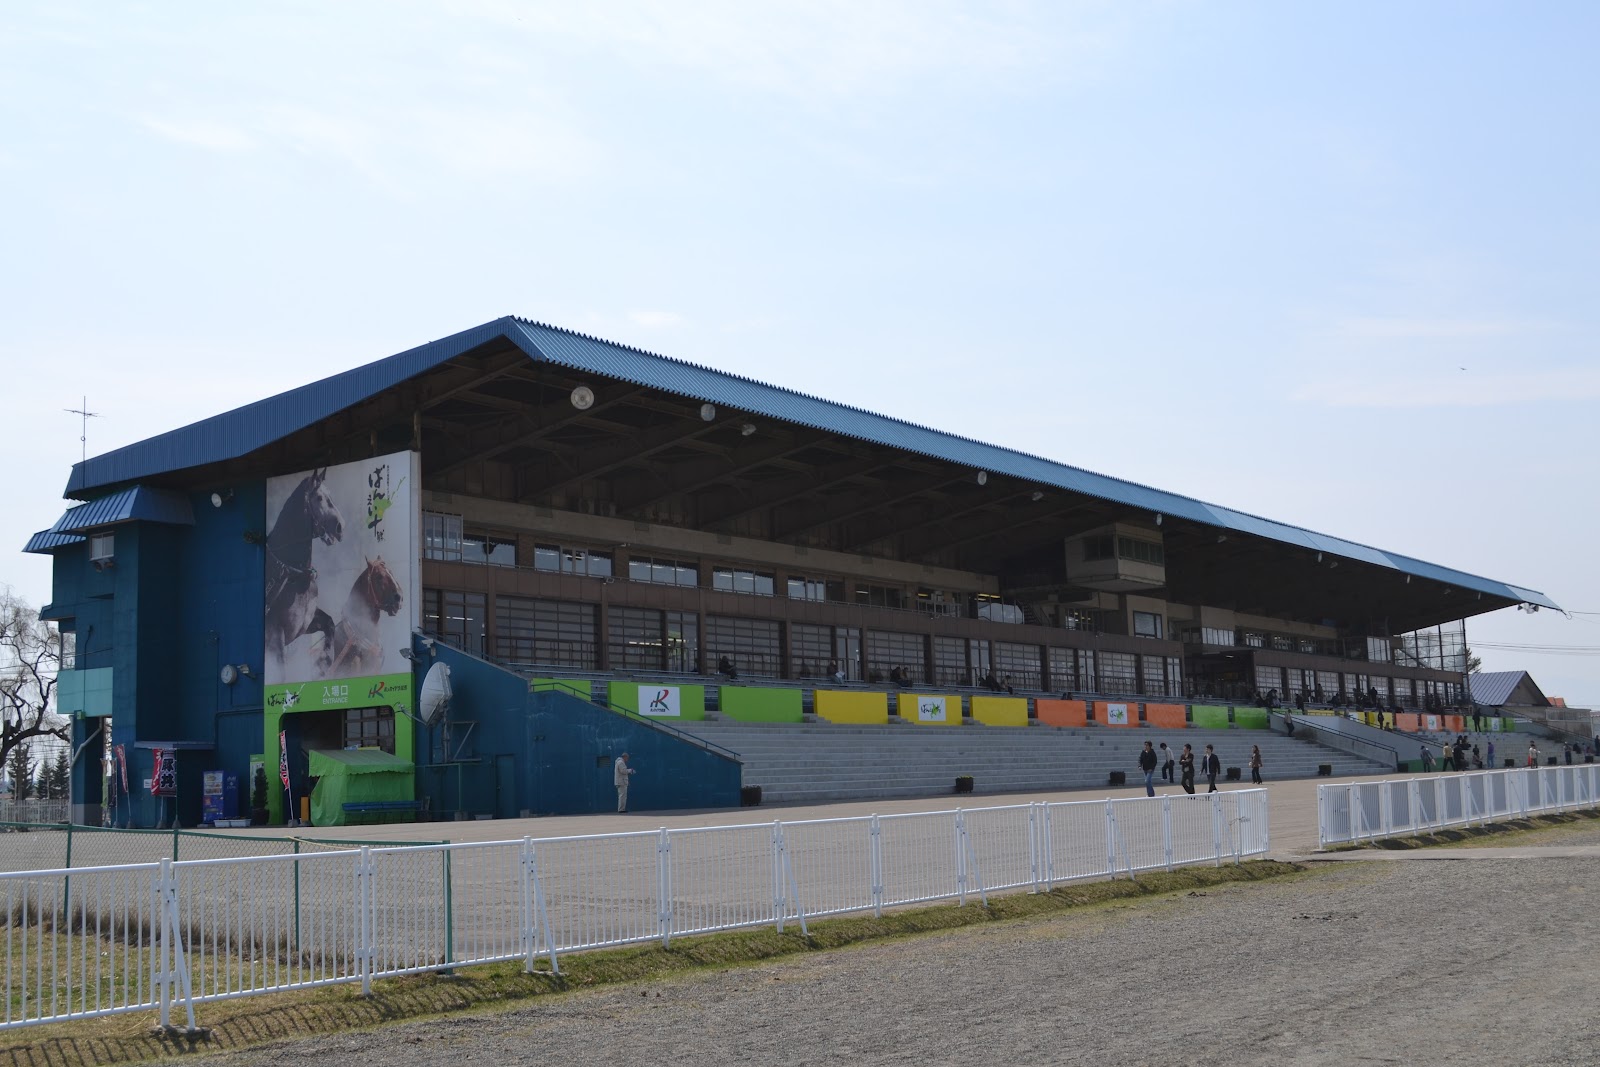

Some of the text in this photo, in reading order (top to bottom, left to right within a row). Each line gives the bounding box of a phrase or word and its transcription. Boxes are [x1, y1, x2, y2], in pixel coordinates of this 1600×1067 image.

[322, 685, 348, 697] 入場口
[161, 758, 174, 788] 豚丼
